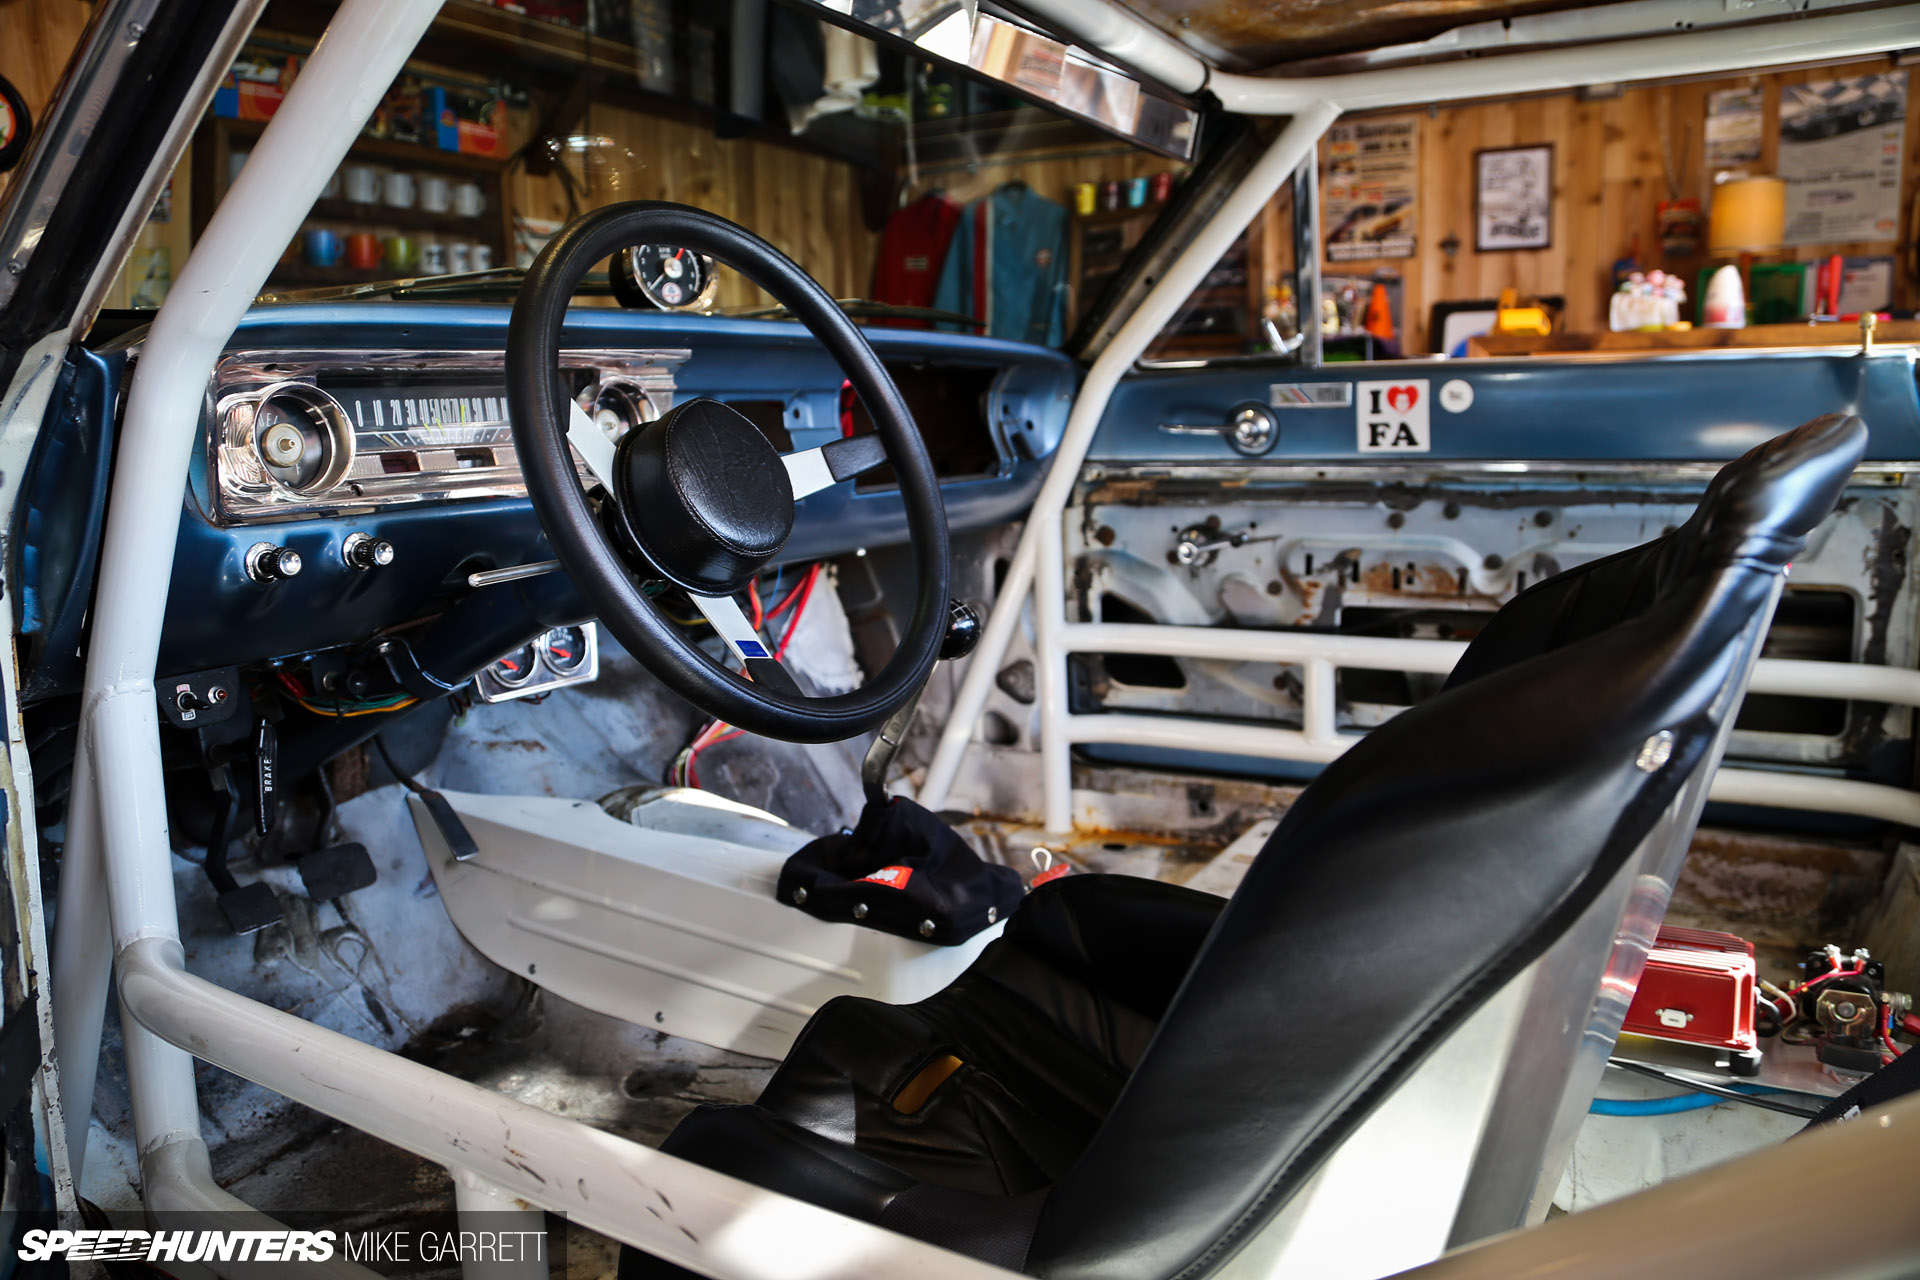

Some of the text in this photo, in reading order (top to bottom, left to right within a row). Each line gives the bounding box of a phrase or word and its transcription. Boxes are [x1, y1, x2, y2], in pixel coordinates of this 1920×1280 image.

[372, 400, 384, 427] 10
[390, 399, 403, 426] 20
[405, 399, 417, 425] 30
[419, 399, 430, 424] 40
[429, 399, 441, 424] 50
[1370, 389, 1381, 414] I
[1368, 421, 1418, 446] FA
[263, 759, 273, 792] BRAKE
